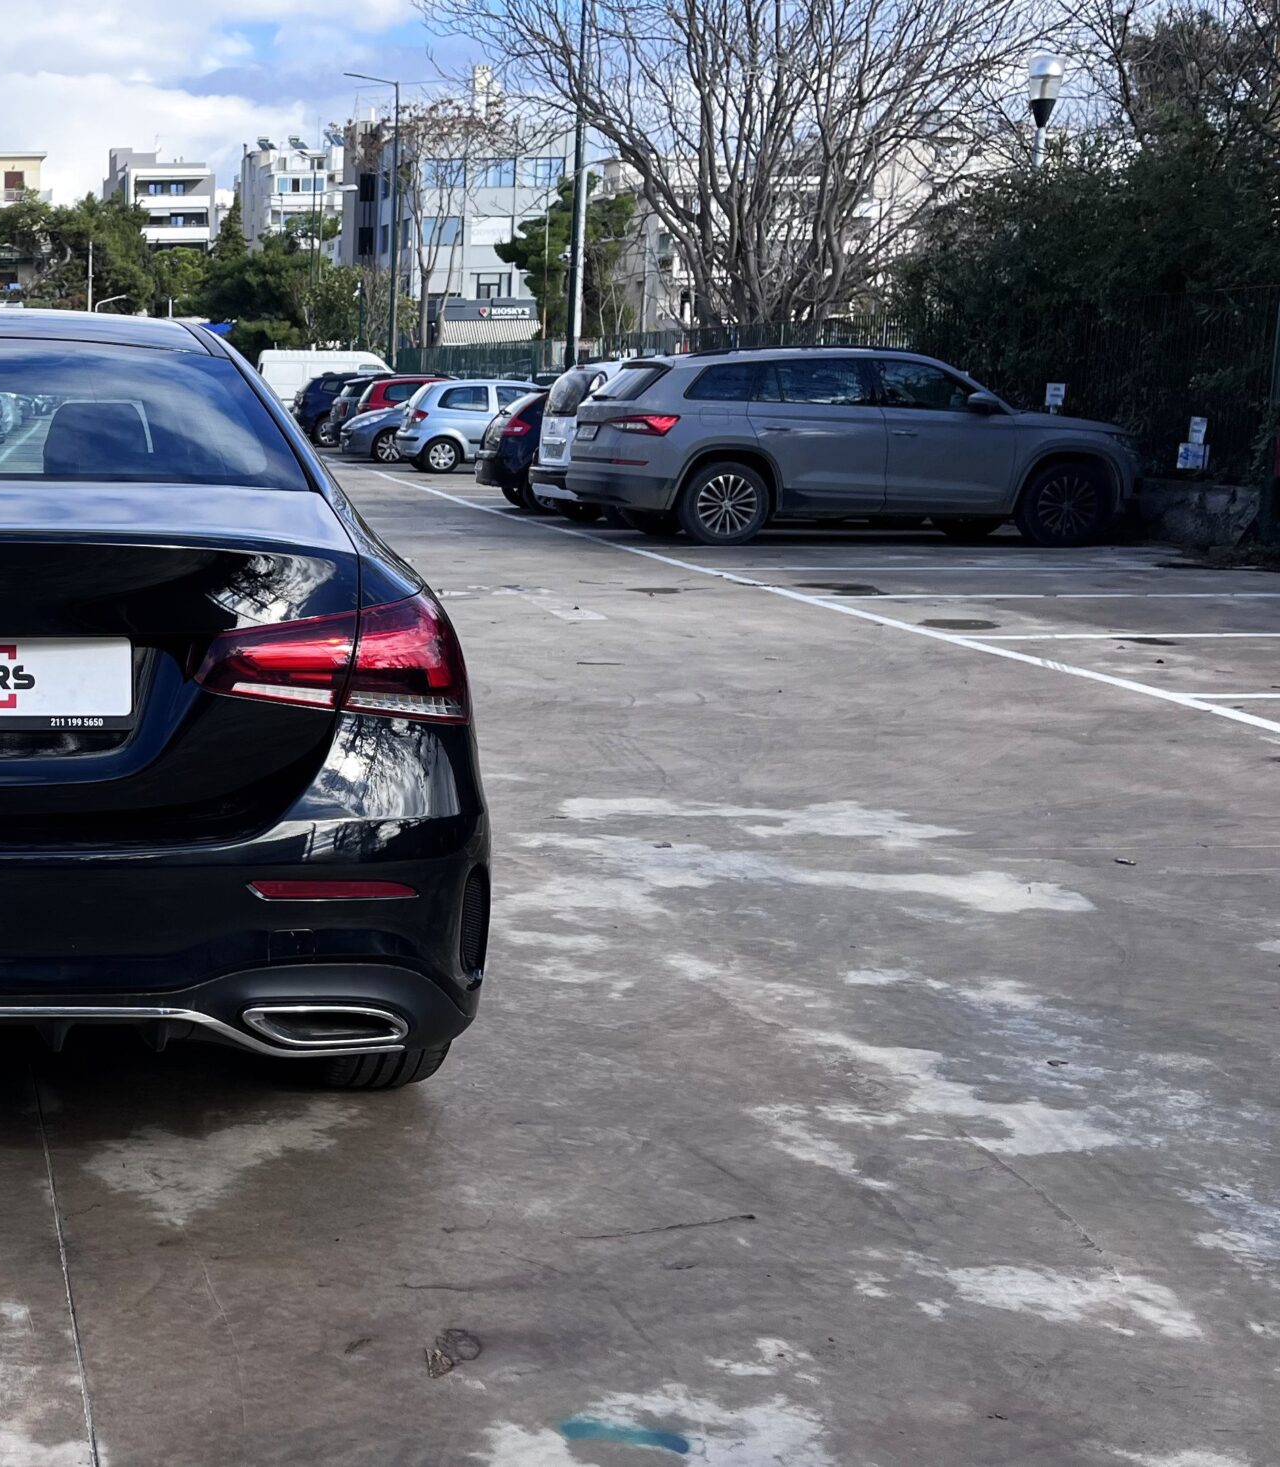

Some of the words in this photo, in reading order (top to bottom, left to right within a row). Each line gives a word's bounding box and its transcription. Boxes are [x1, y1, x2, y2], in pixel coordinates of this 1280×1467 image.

[491, 307, 530, 315] KIOSKY'S
[50, 718, 65, 727] 211
[67, 718, 82, 727] 199
[83, 718, 104, 727] 5650
